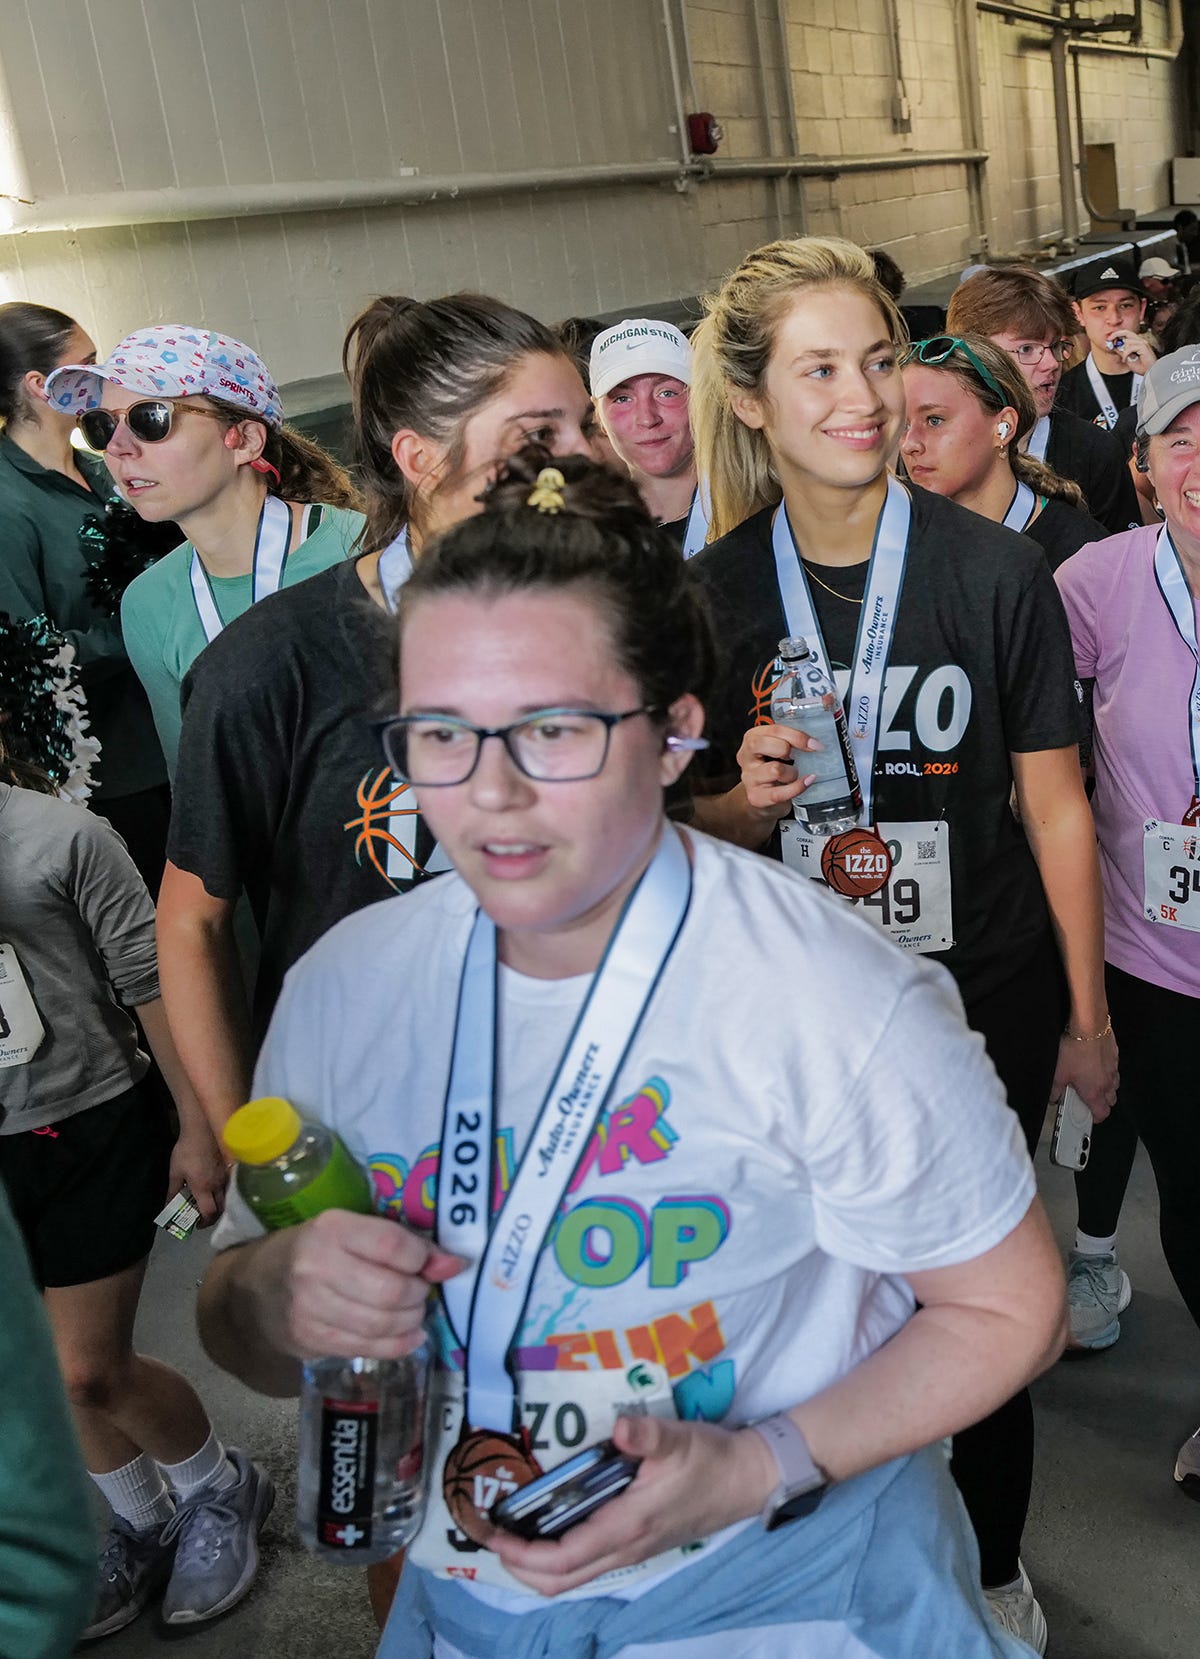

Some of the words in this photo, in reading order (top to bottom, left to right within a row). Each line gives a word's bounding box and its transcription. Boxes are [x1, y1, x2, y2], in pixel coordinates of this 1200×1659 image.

[599, 327, 648, 353] MICHIGAN
[649, 328, 681, 348] STATE
[864, 595, 884, 675] Auto-Owners
[874, 611, 889, 660] INSURANCE
[857, 696, 870, 725] IZZO
[923, 762, 959, 775] 2026
[801, 844, 810, 857] H
[860, 846, 872, 854] the
[1162, 840, 1171, 851] C
[845, 854, 887, 873] IZZO
[1160, 904, 1178, 922] 5K
[896, 934, 932, 943] -Owners
[537, 1042, 600, 1178] Auto-Owners
[561, 1073, 603, 1155] INSURANCE
[450, 1112, 481, 1227] 2026
[505, 1213, 533, 1266] IZZO
[552, 1195, 732, 1289] OP
[331, 1418, 360, 1514] essentia
